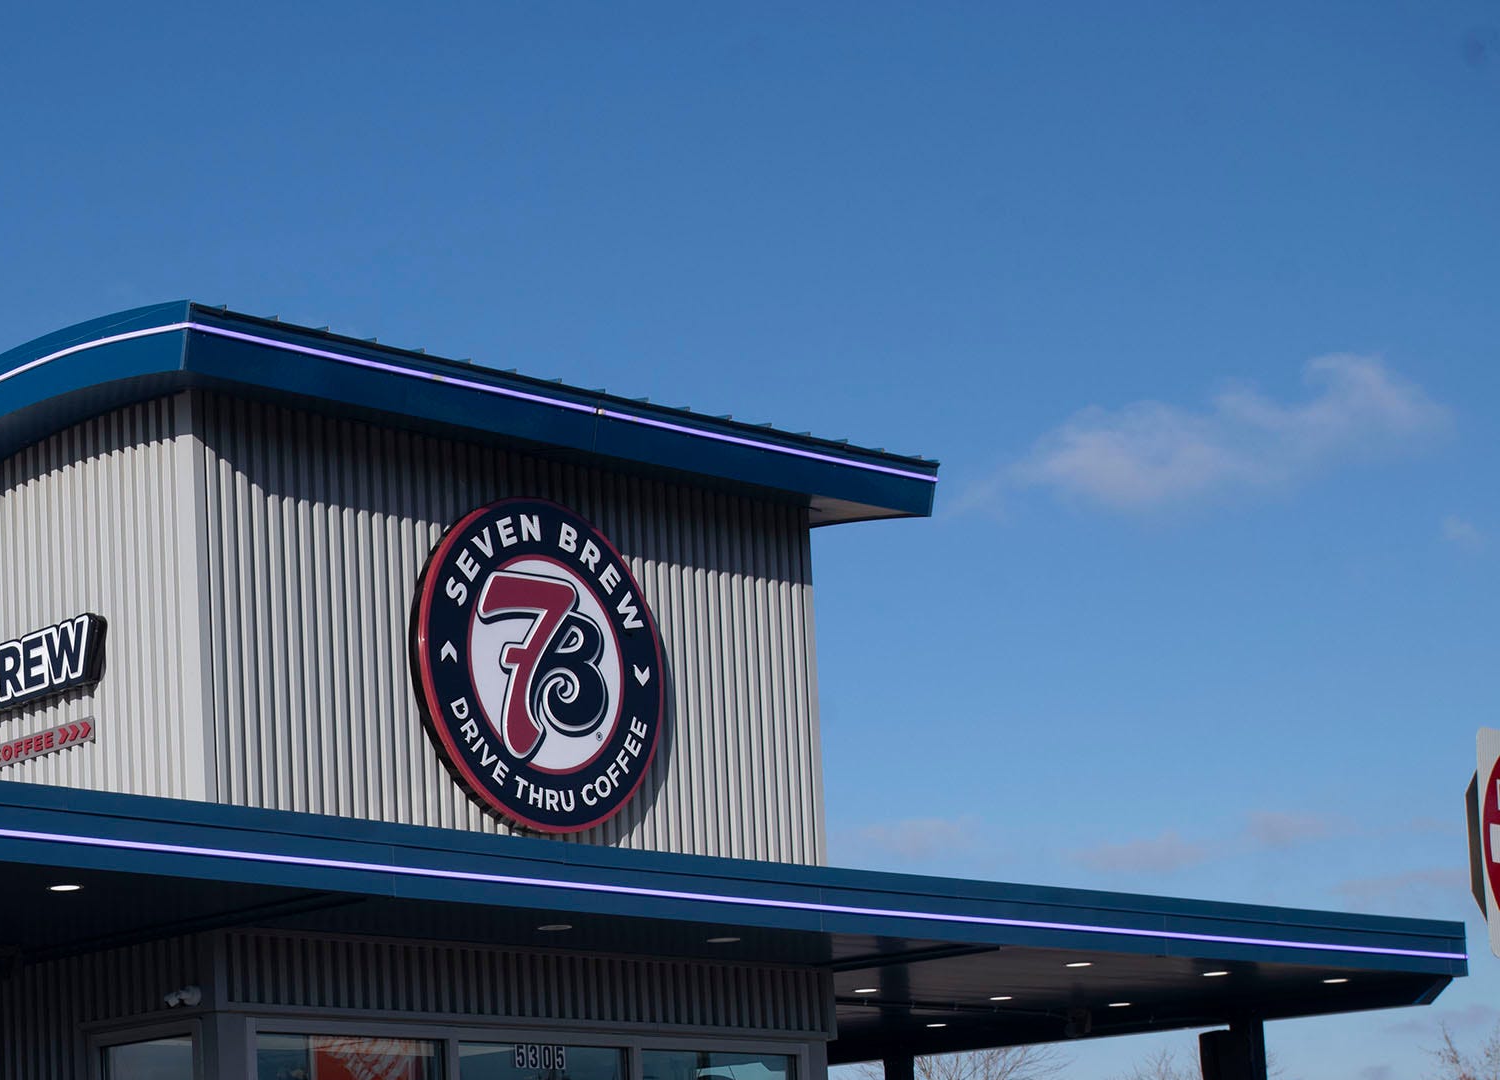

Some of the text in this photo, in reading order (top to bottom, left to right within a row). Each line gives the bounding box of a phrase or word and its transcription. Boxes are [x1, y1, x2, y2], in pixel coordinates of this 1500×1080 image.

[446, 514, 644, 631] SEVEN BREW
[451, 696, 647, 812] DRIVE THRU COFFEE
[516, 1044, 565, 1069] 5305
